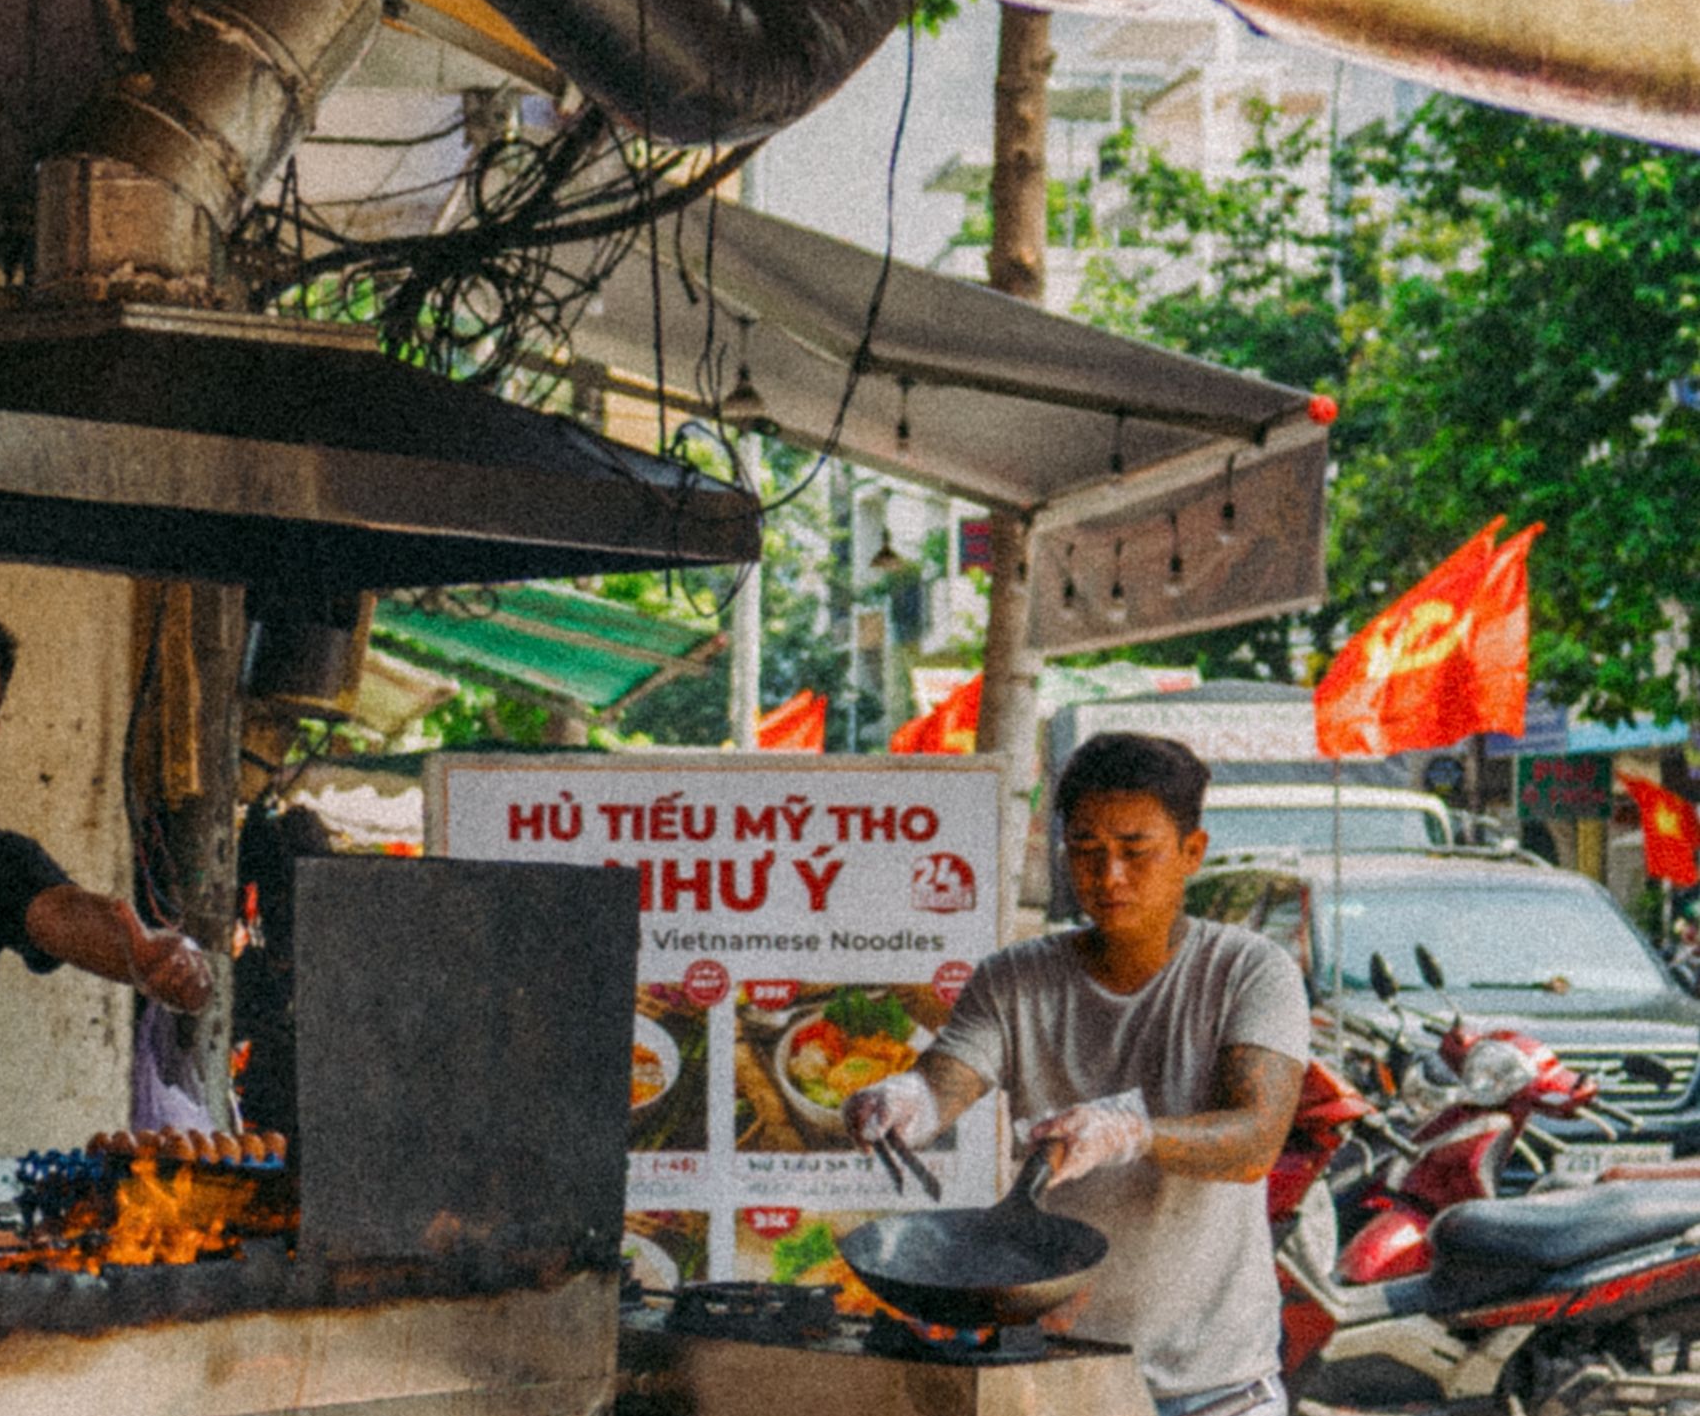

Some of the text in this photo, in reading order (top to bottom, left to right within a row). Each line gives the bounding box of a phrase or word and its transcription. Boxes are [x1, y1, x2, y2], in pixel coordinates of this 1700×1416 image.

[508, 790, 940, 843] HỦ TIẾU MỸ THO
[792, 844, 845, 913] Ý
[652, 930, 946, 952] Vietnamese Noodles
